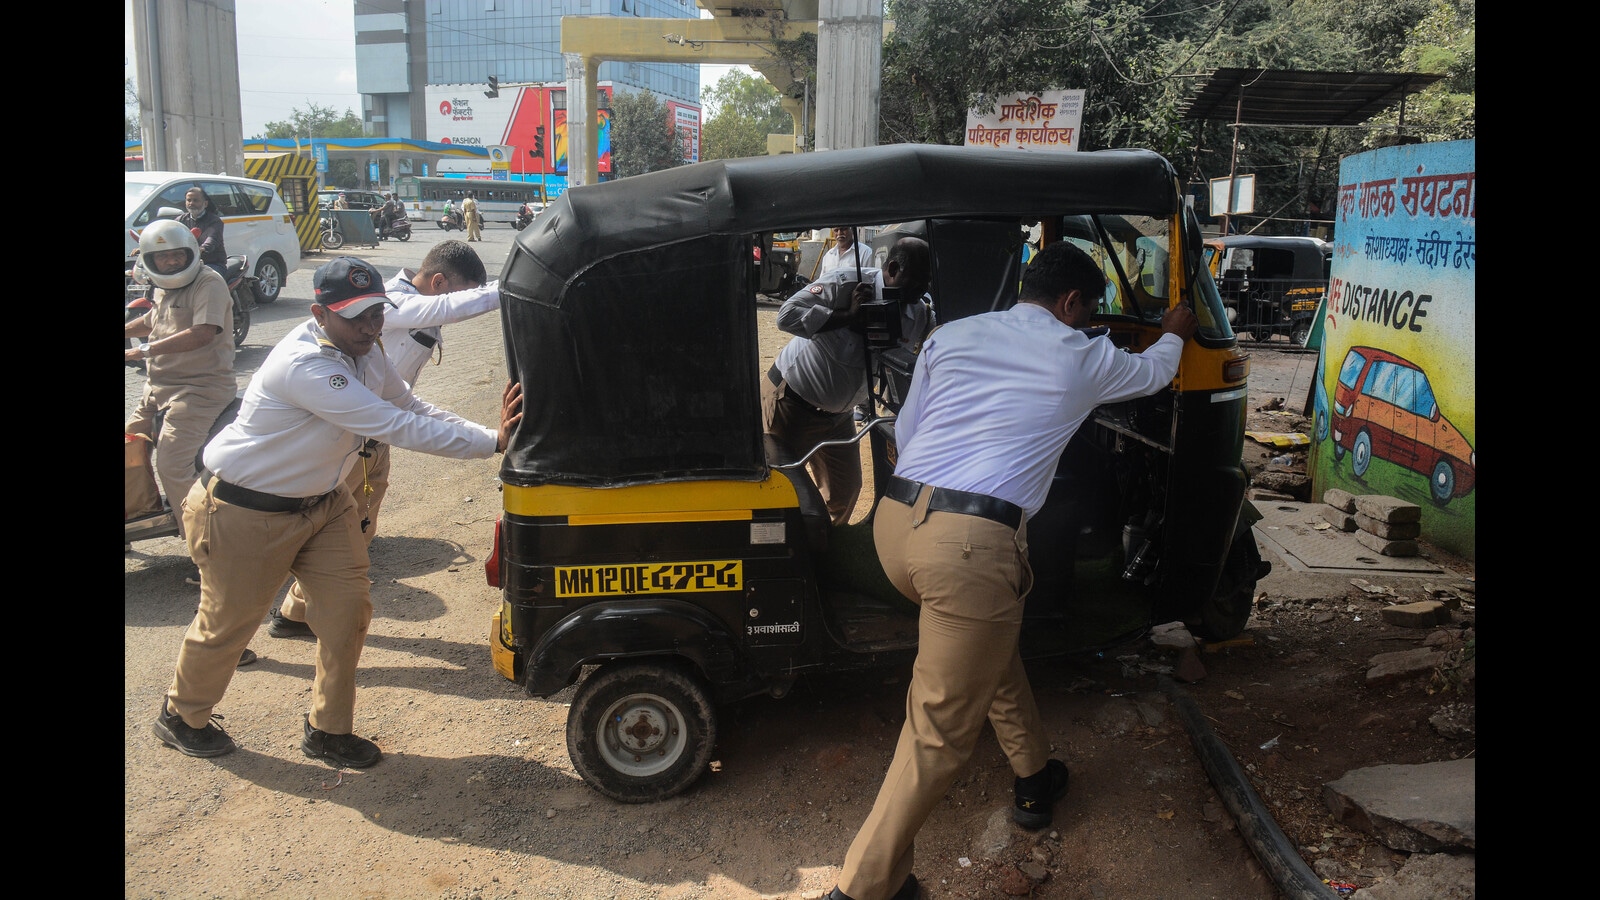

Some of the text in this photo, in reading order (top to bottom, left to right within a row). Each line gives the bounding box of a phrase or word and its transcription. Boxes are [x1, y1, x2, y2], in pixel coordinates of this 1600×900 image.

[968, 121, 1075, 147] परिवहन कार्यालय
[1415, 230, 1452, 269] संदीप
[1341, 282, 1432, 332] DISTANCE
[753, 621, 800, 633] प्रवाशांसाठी
